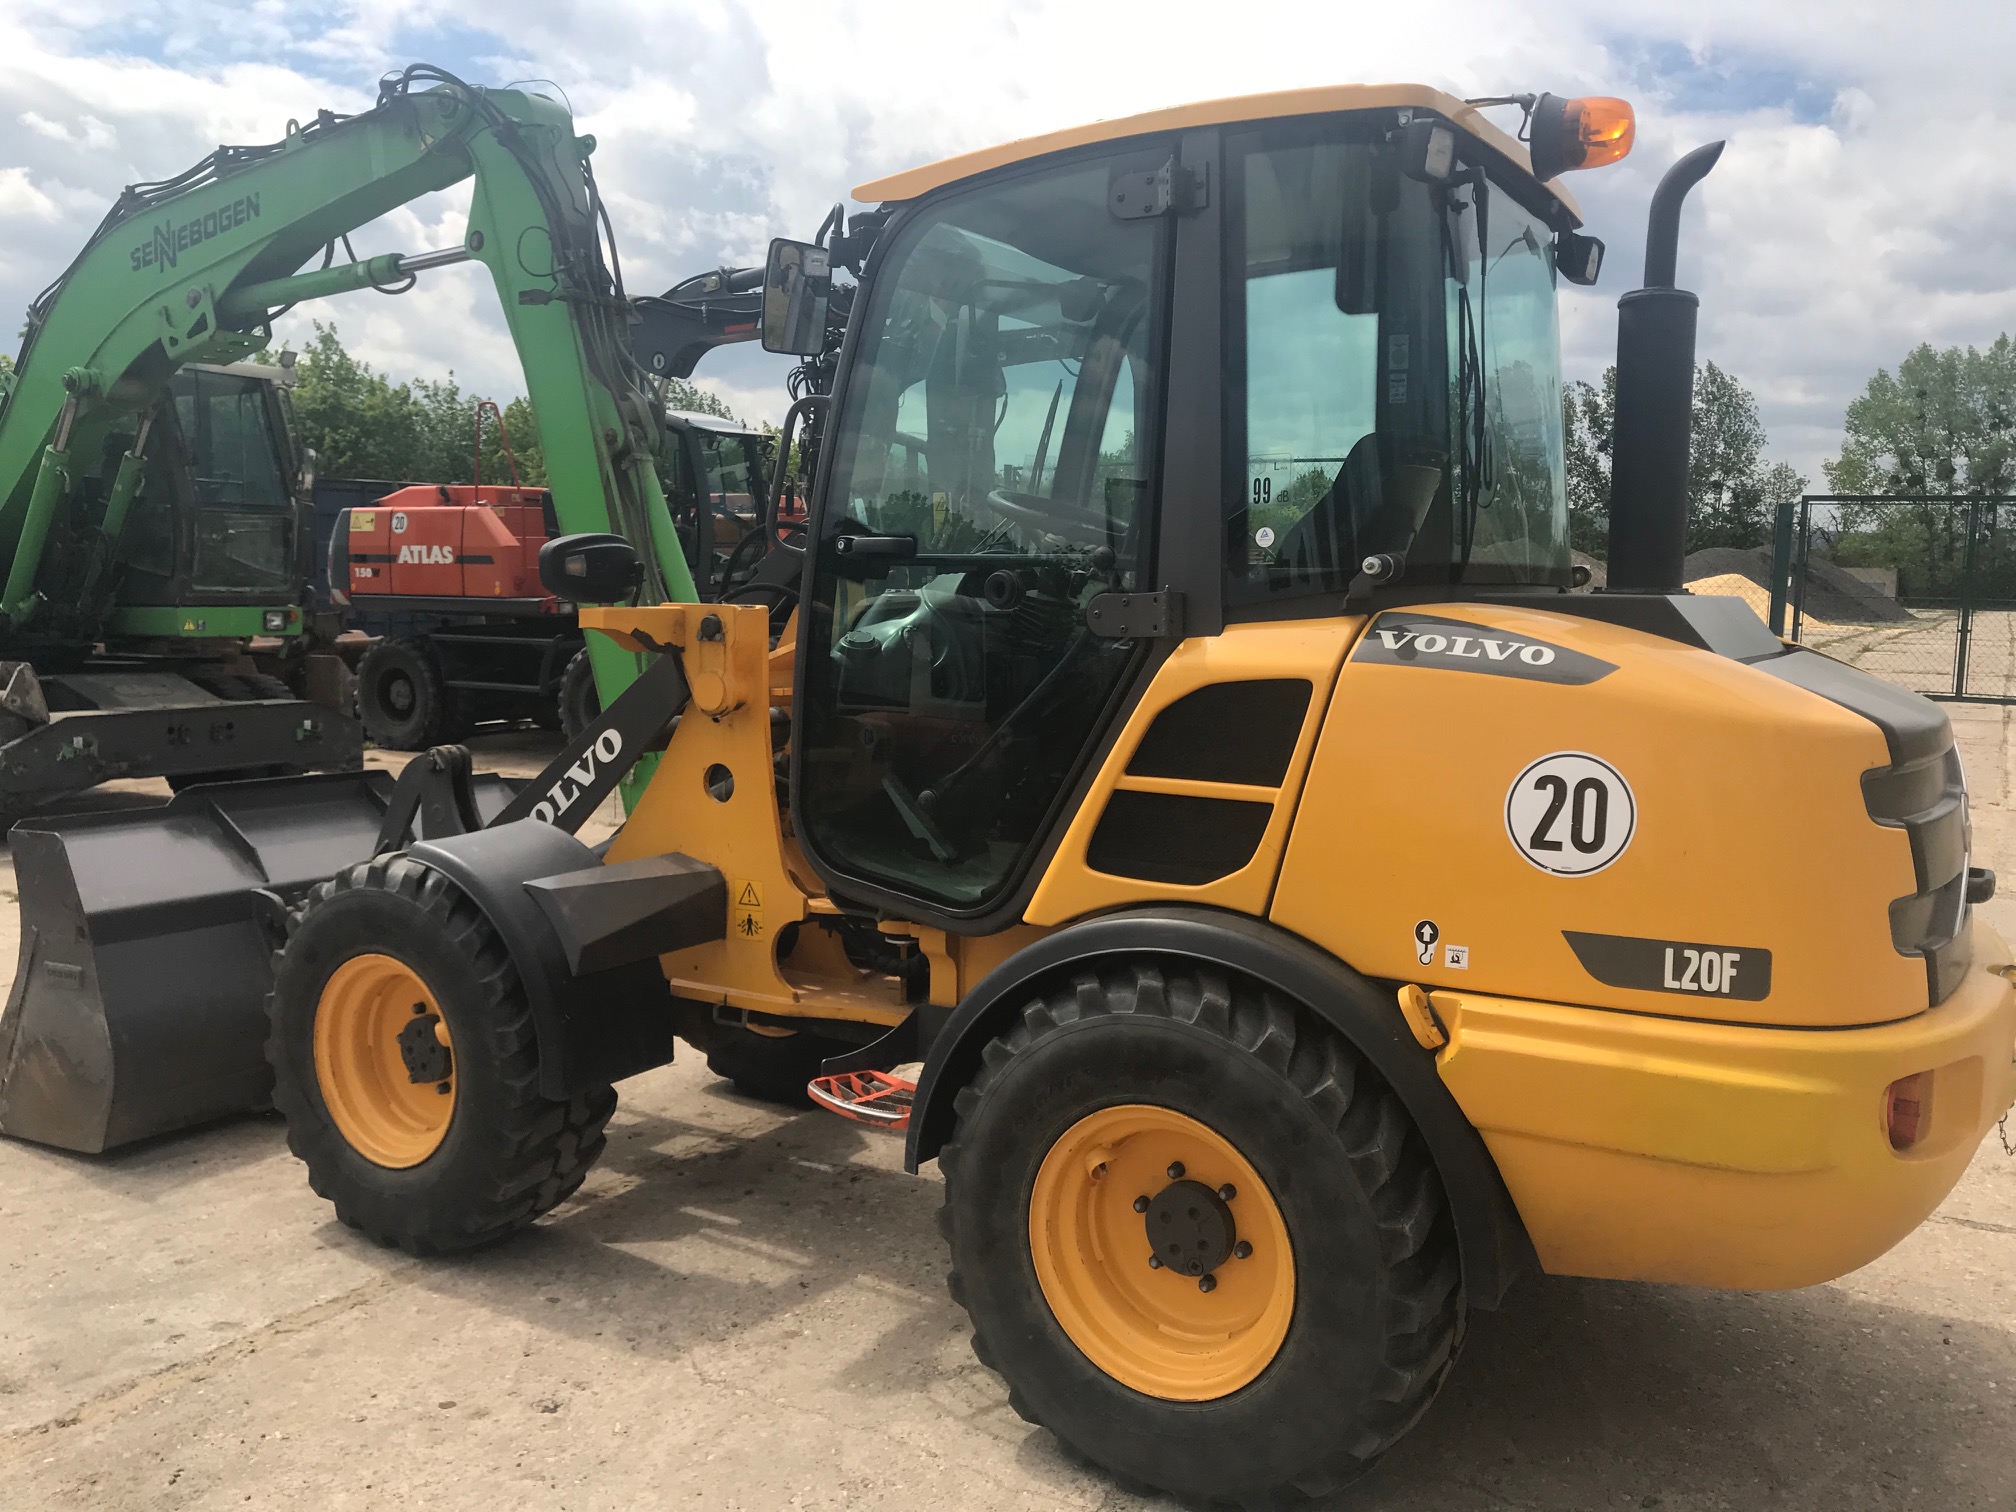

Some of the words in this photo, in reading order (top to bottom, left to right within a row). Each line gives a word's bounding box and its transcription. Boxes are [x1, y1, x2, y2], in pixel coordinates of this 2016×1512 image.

[130, 192, 260, 273] SENNEBOGEN
[1253, 477, 1271, 504] 99
[1277, 490, 1289, 502] dB
[395, 516, 404, 530] 20
[398, 545, 454, 564] ATLAS
[1375, 629, 1556, 666] VOLVO
[528, 728, 623, 825] OLVO
[1530, 774, 1609, 854] 20
[1664, 948, 1741, 994] L20F
